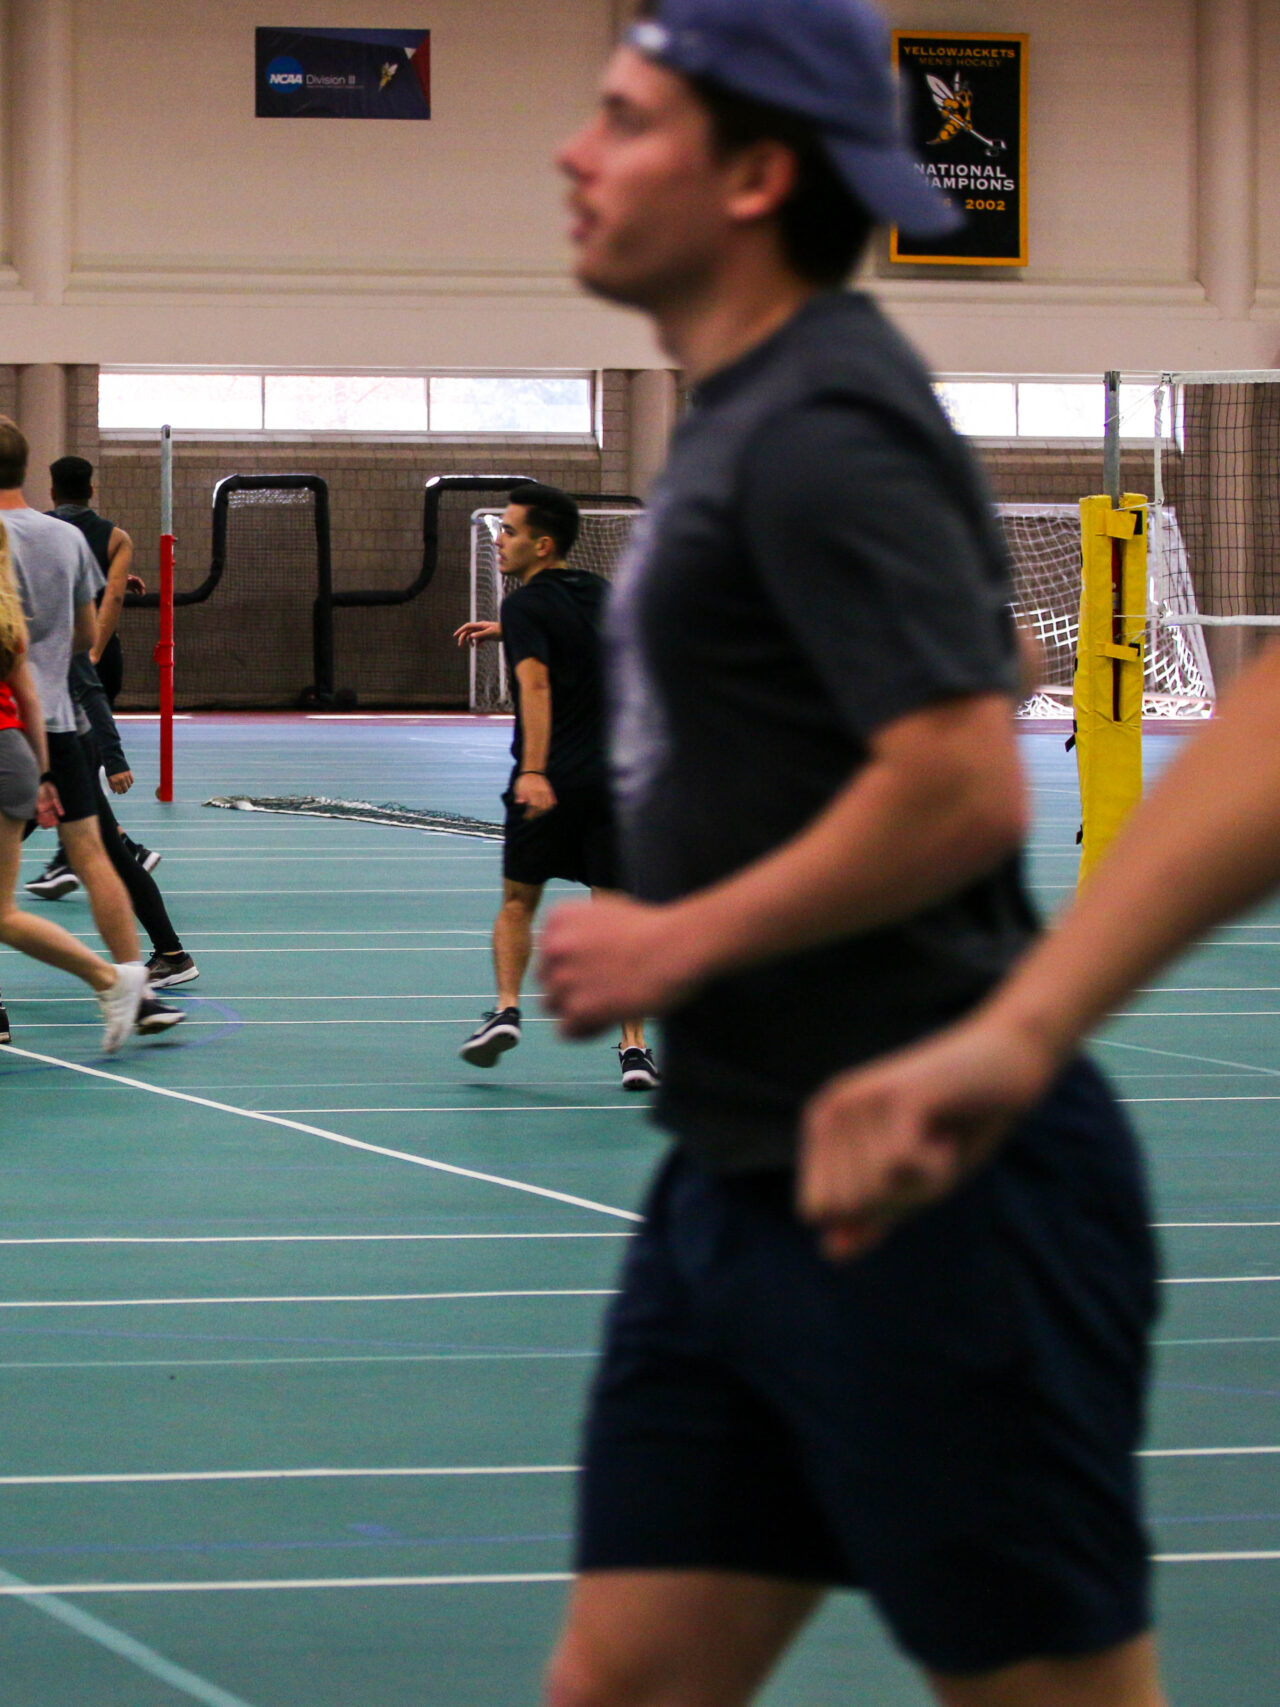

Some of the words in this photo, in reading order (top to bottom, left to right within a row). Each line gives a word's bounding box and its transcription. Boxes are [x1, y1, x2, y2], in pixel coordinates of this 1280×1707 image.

[904, 46, 1016, 58] YELLOWJACKETS
[919, 58, 952, 66] MEN'S
[956, 58, 1002, 67] HOCKEY
[270, 74, 303, 84] NCAA
[306, 74, 346, 84] Division
[913, 163, 1007, 177] NATIONAL
[923, 177, 1015, 191] AMPIONS
[965, 199, 1006, 211] 2002
